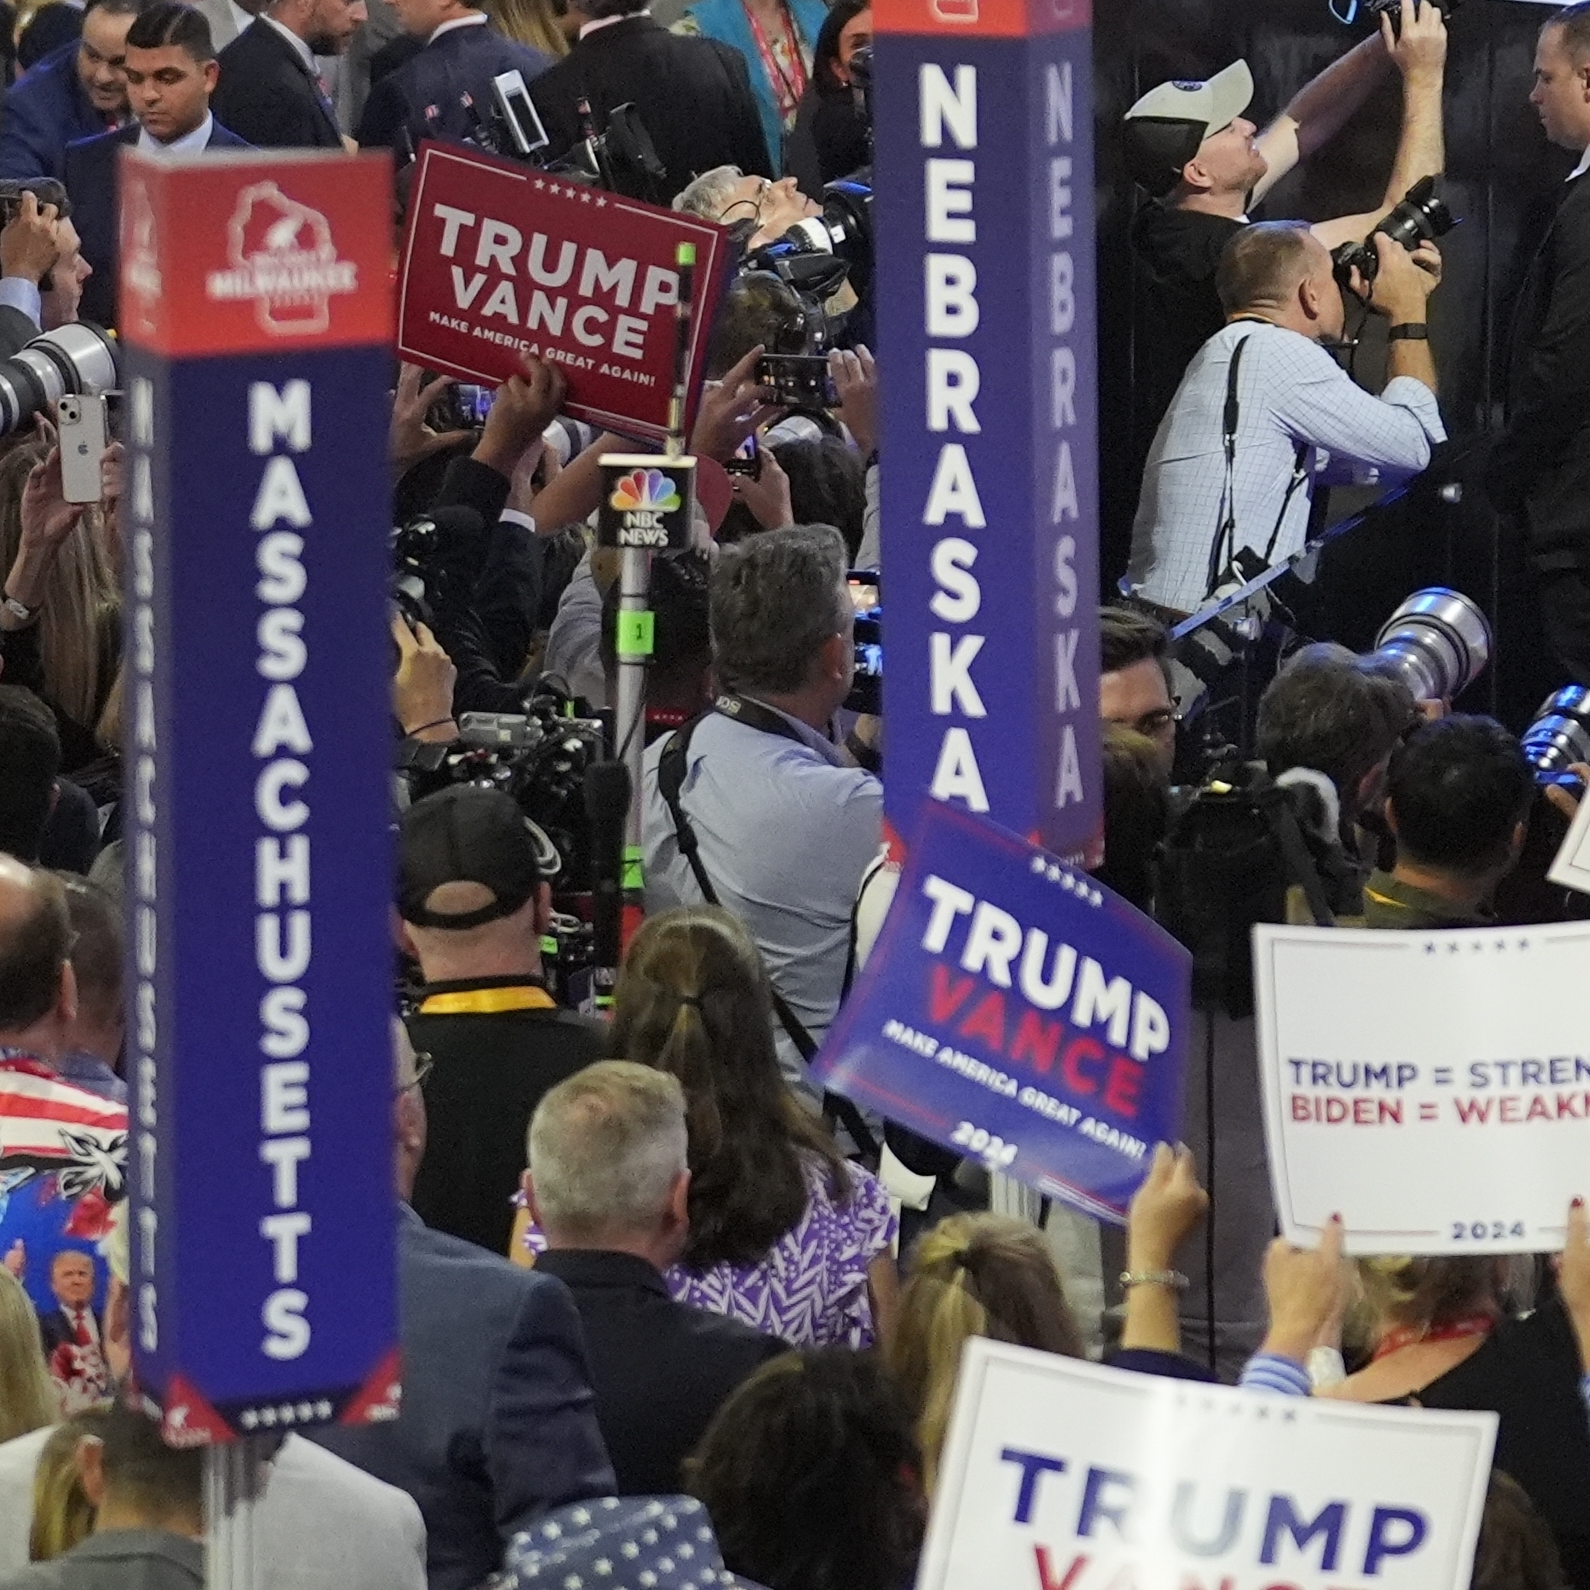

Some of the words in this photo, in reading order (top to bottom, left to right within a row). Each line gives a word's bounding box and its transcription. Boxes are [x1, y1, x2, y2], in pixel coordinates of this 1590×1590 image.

[432, 203, 681, 316] TRUMP
[428, 310, 470, 334] MAKE
[471, 324, 539, 356] AMERICA
[545, 343, 597, 369] GREAT
[600, 361, 656, 387] AGAIN!
[448, 265, 650, 360] VANCE
[918, 62, 989, 812] NEBRASKA
[1045, 61, 1084, 809] NEBRASKA
[619, 528, 669, 547] NEWS
[624, 511, 664, 528] NBC
[246, 378, 312, 1364] MASSACHUSETTS
[921, 872, 1172, 1063] TRUMP
[882, 1017, 939, 1059] MAKE
[935, 1044, 1020, 1100] AMERICA
[1017, 1084, 1083, 1129] GREAT
[1077, 1115, 1148, 1161] AGAIN!
[926, 963, 1147, 1120] VANCE
[1287, 1058, 1418, 1090] TRUMP
[950, 1119, 1020, 1169] 2024
[1290, 1093, 1404, 1125] BIDEN
[1419, 1103, 1439, 1122] =
[1450, 1221, 1526, 1242] 2024
[1000, 1446, 1433, 1577] TRUMP
